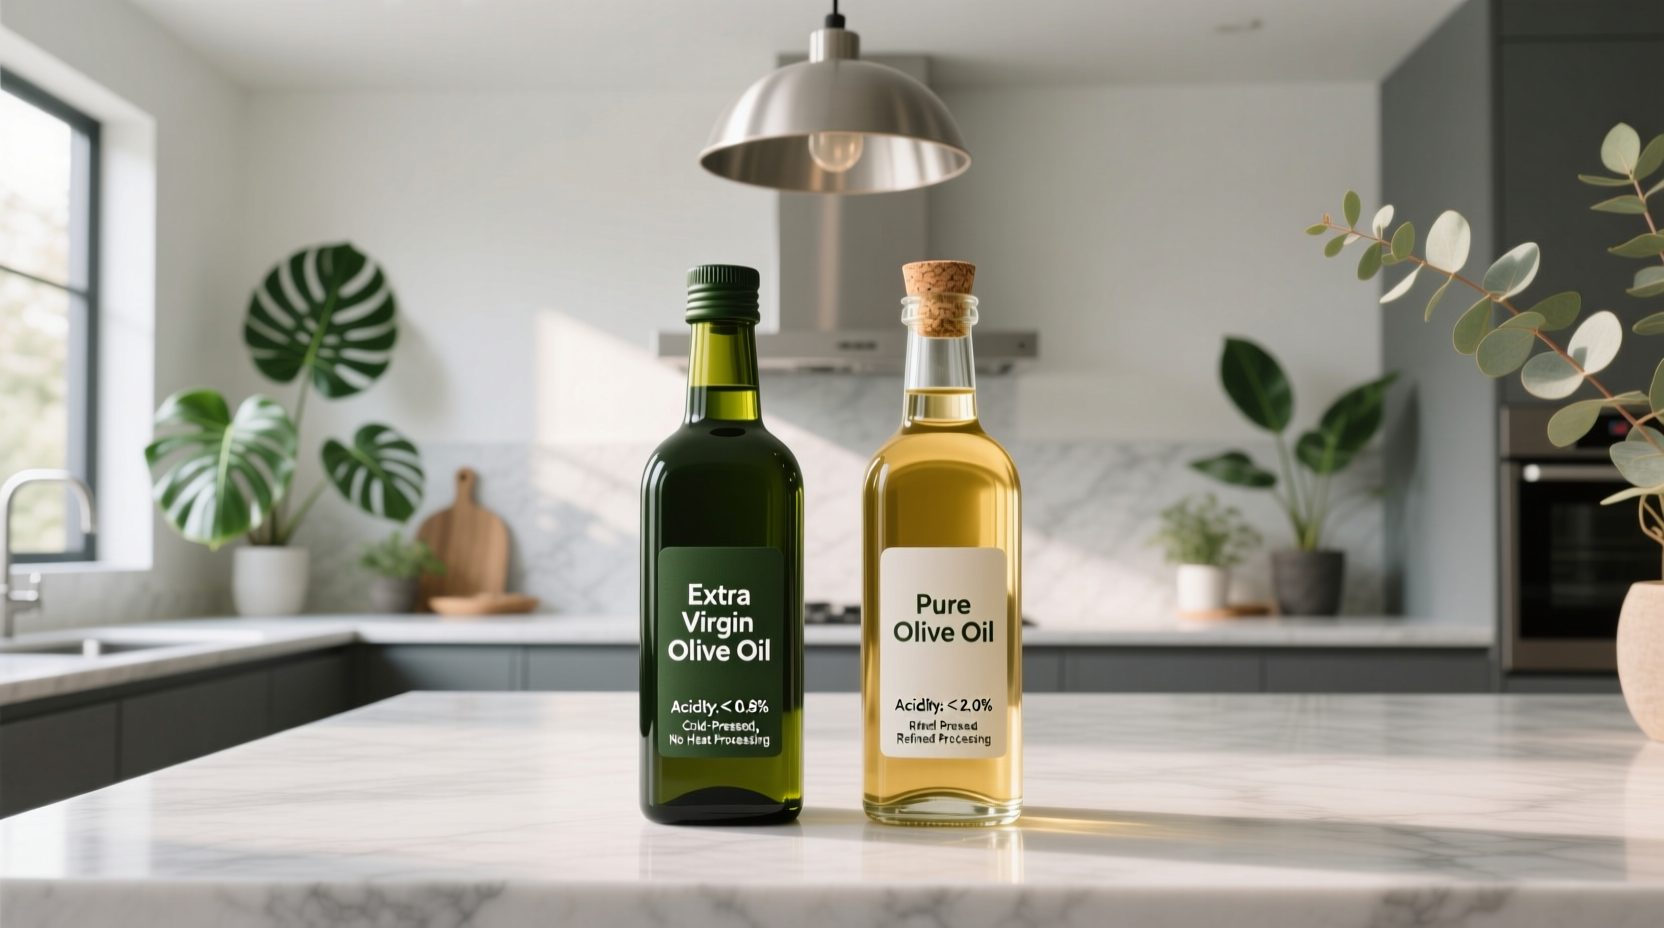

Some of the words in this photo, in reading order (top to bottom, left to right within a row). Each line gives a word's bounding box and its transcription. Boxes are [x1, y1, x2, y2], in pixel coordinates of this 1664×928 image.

[688, 583, 751, 606] Extra
[916, 593, 972, 615] Pure
[681, 610, 754, 640] Virgin
[893, 621, 956, 643] Olive
[961, 620, 994, 643] Oil
[667, 638, 731, 662] Olive
[736, 638, 771, 662] Oil
